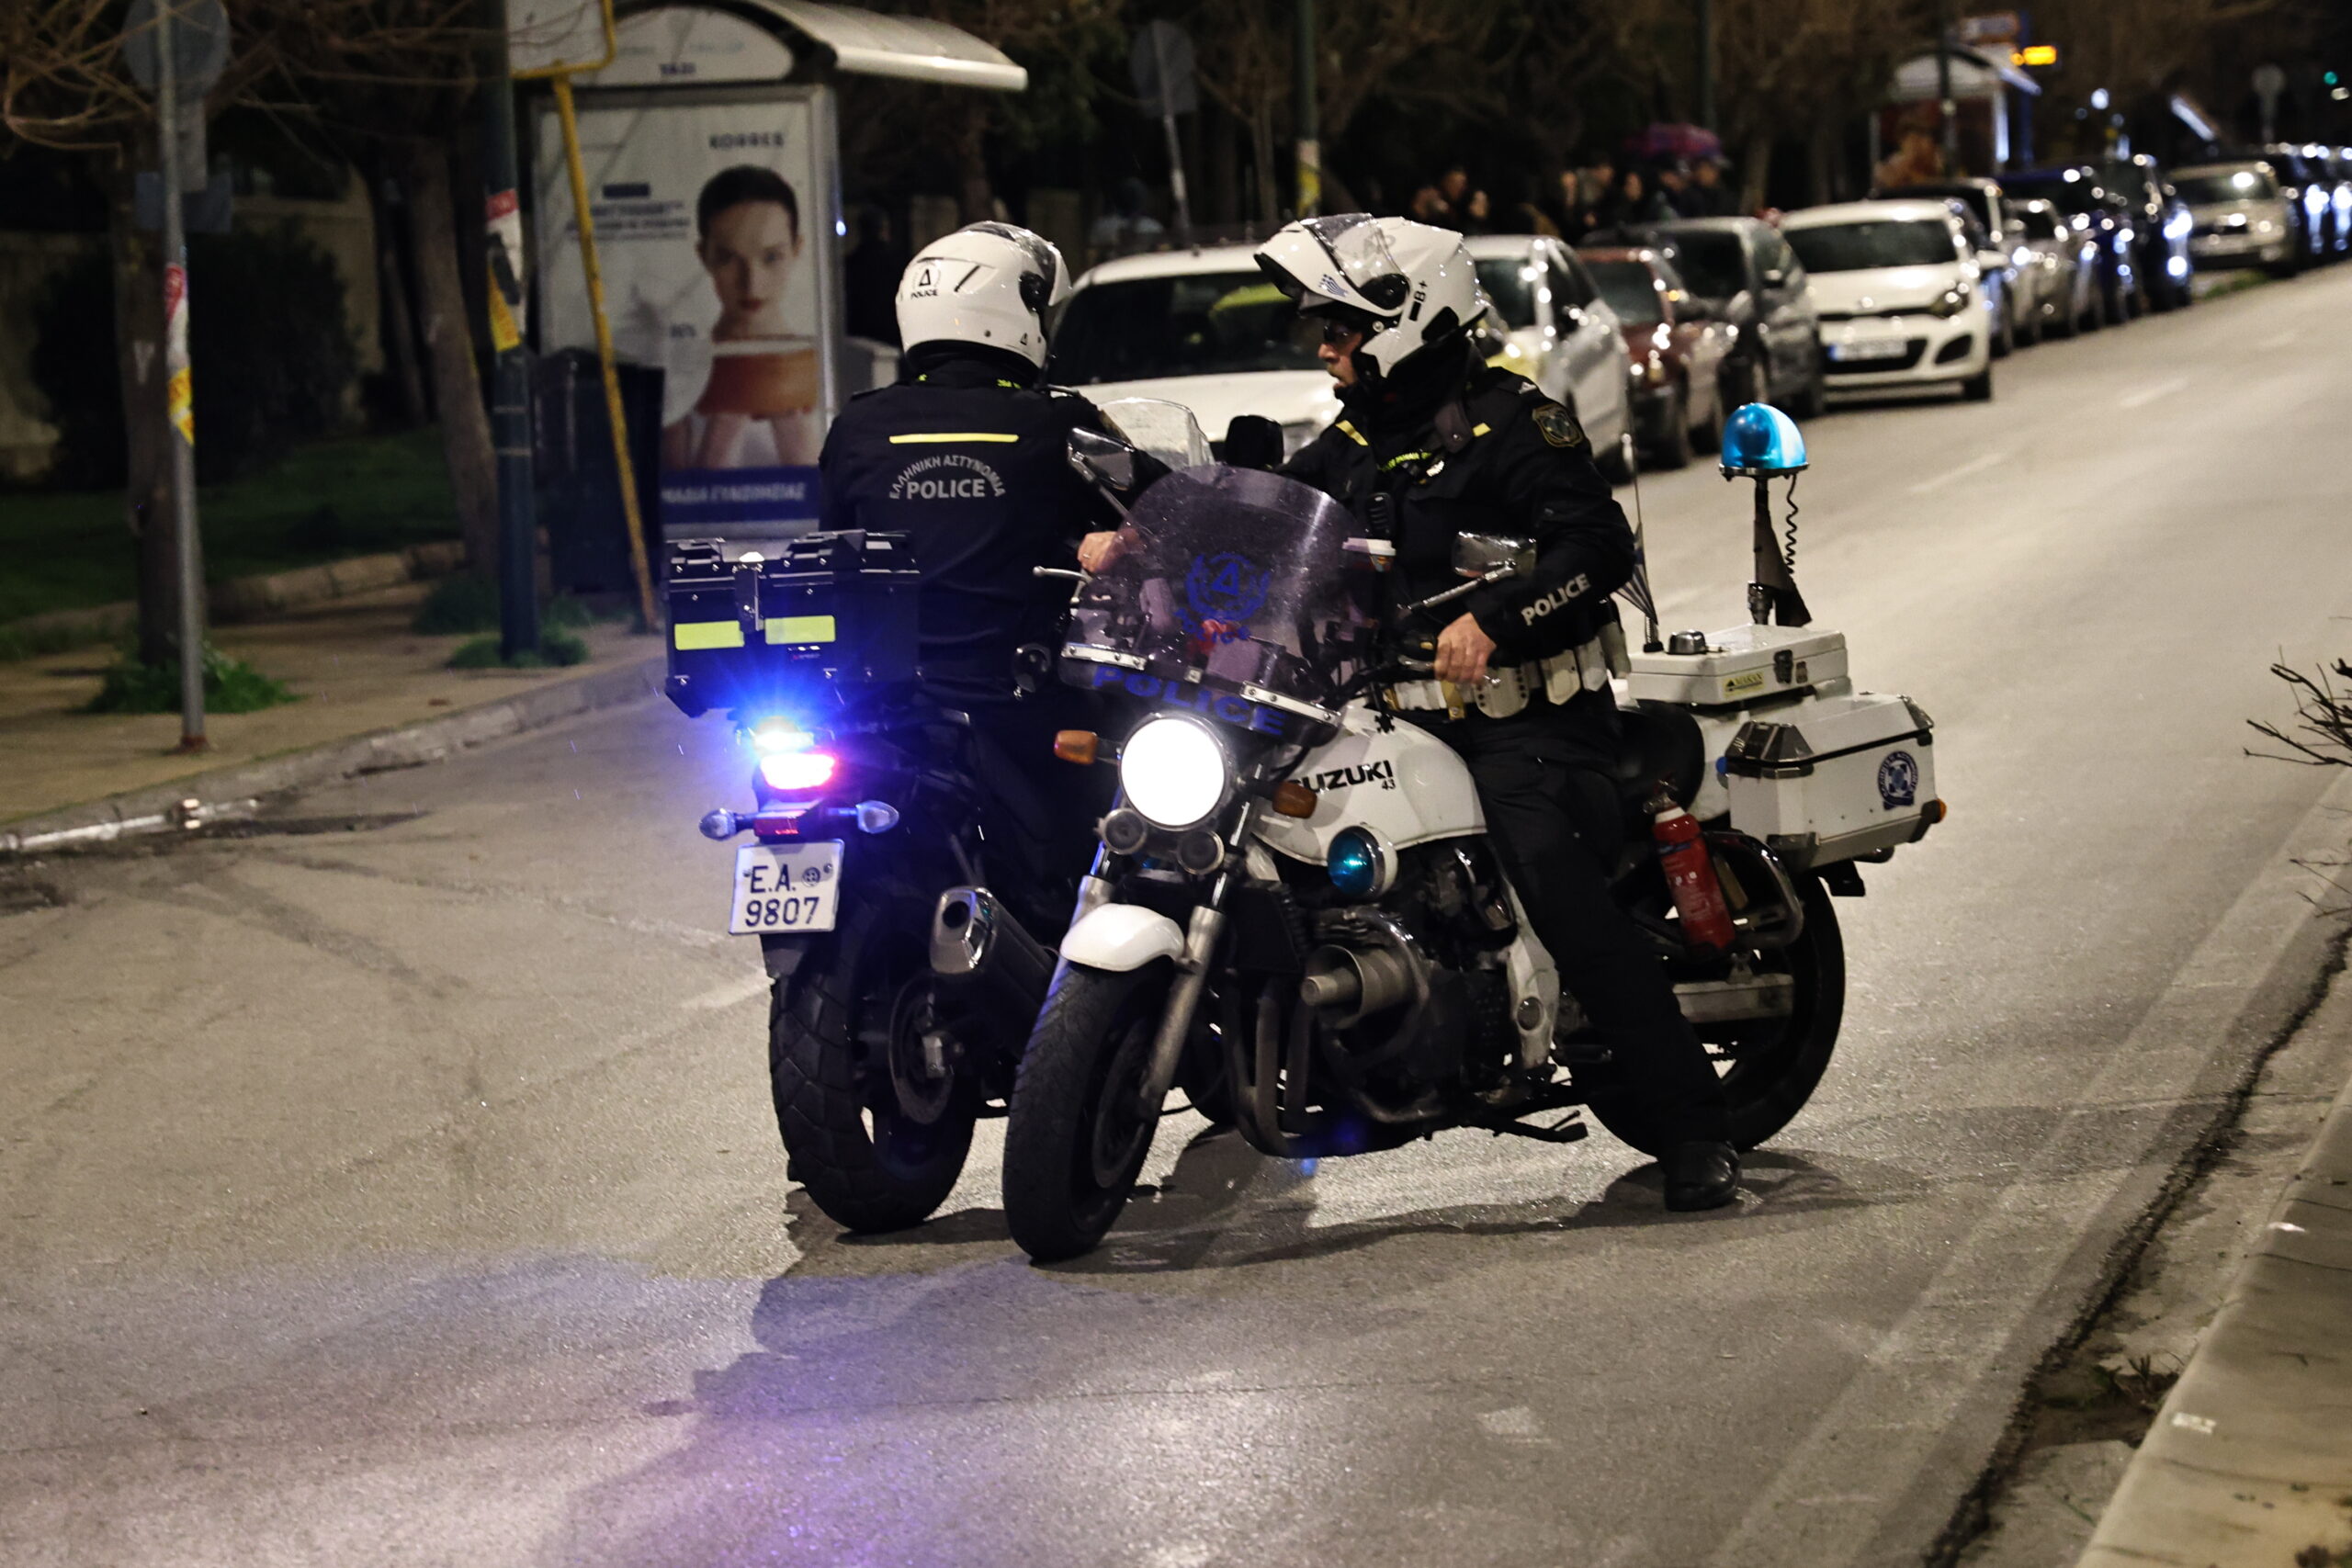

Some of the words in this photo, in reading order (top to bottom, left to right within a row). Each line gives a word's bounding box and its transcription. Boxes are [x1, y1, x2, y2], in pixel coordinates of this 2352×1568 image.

[889, 455, 942, 500] ΕΛΛΗΝΙΚΗ
[943, 454, 1006, 498] ΑΣΤΥΝΟΜΙΑ
[906, 479, 986, 500] POLICE
[1521, 572, 1591, 627] POLICE
[1091, 665, 1288, 737] POLICE
[1381, 779, 1397, 792] 43
[745, 897, 820, 928] 9807
